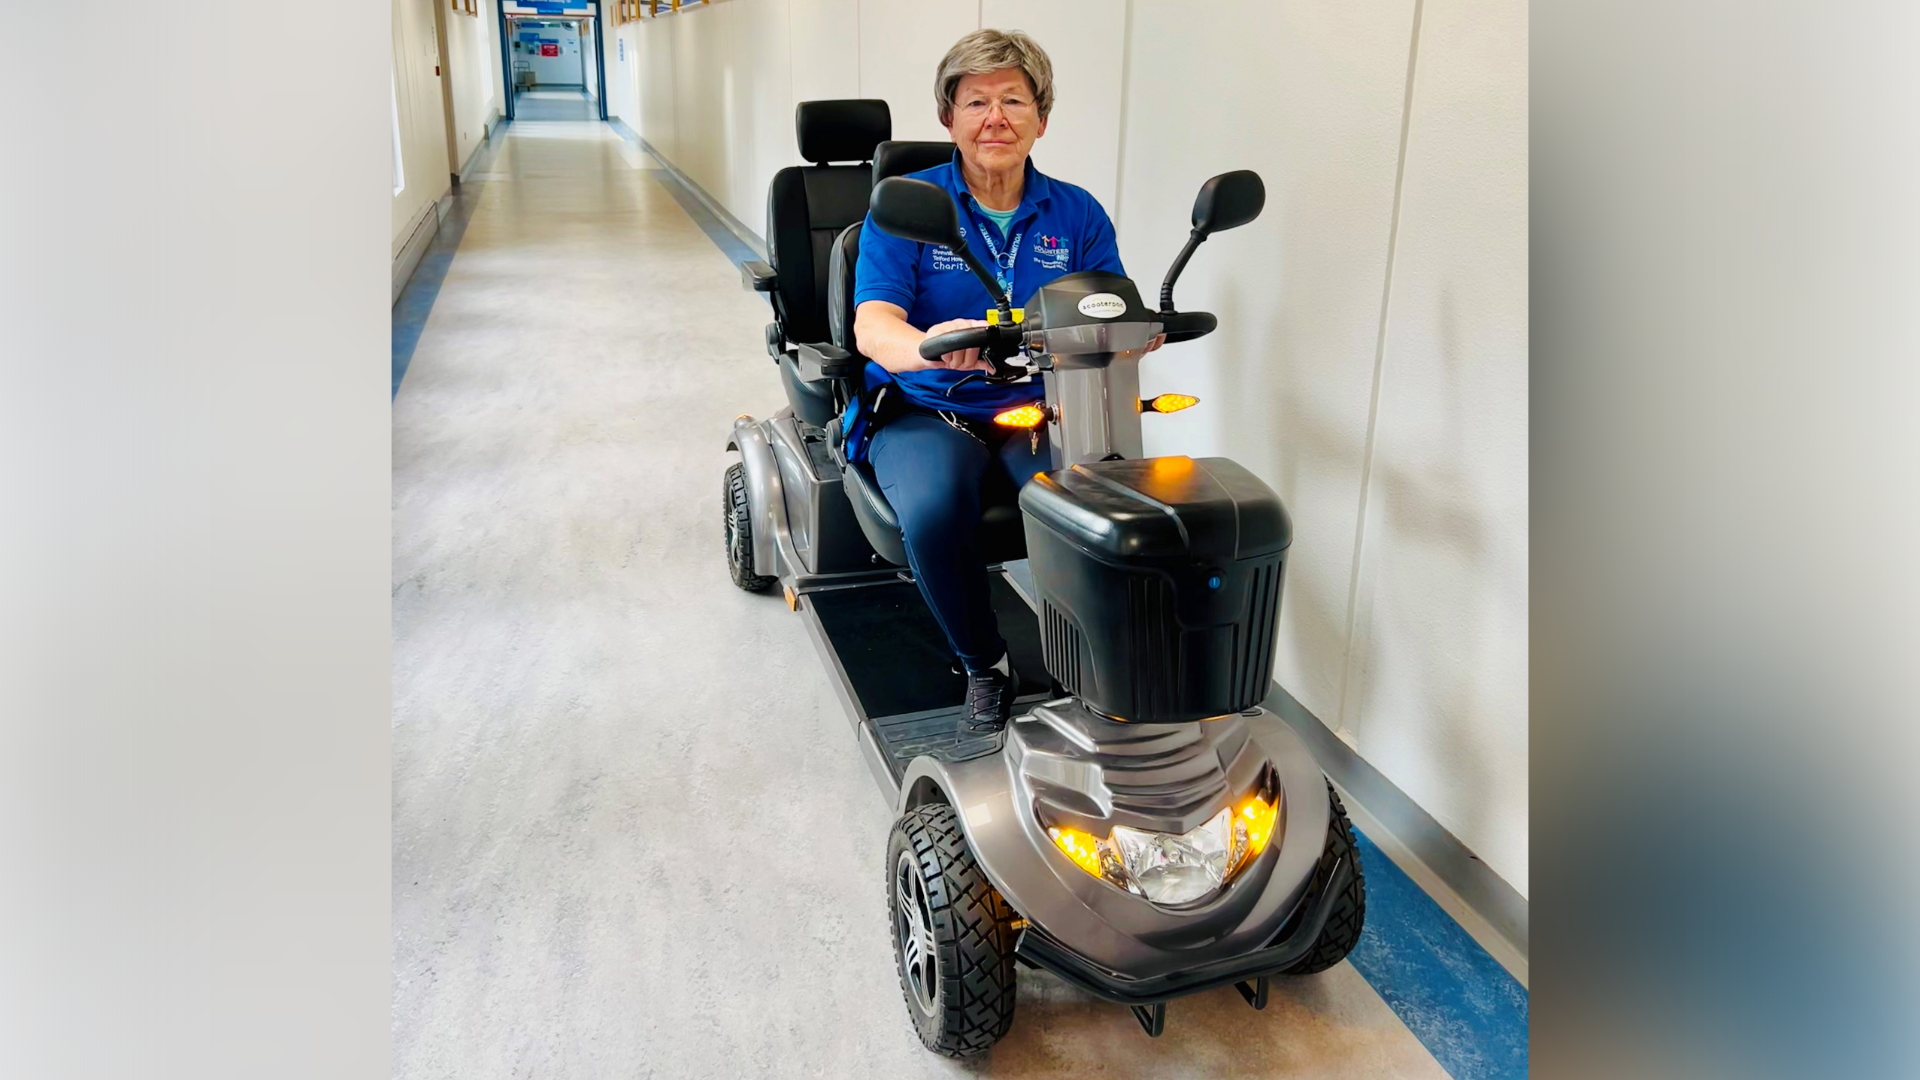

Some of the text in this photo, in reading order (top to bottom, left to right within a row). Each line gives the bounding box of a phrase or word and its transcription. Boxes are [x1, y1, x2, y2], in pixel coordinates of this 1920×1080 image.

[978, 222, 998, 259] VOLUNTEER
[1008, 233, 1023, 269] VOLUNTEER
[932, 261, 971, 272] Charity
